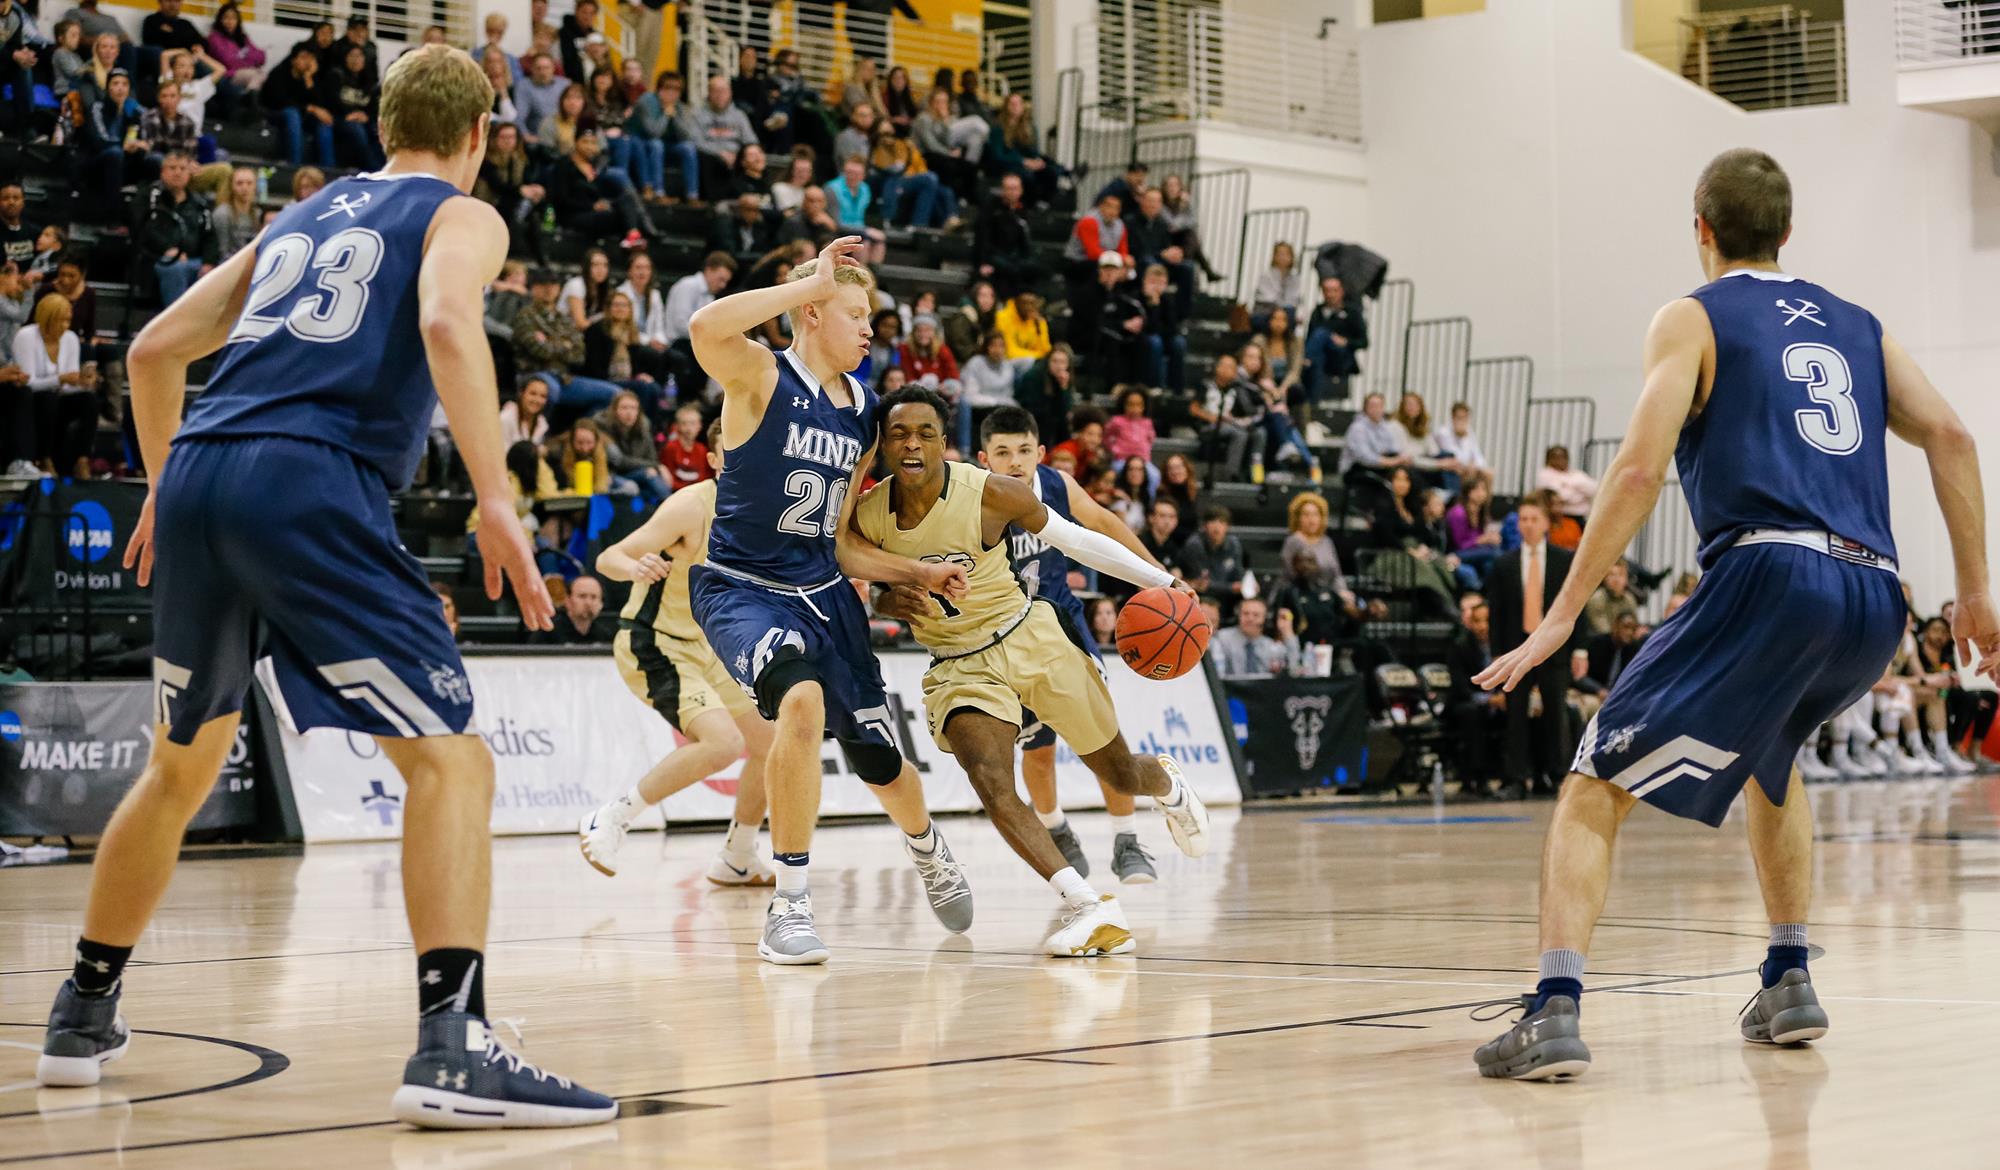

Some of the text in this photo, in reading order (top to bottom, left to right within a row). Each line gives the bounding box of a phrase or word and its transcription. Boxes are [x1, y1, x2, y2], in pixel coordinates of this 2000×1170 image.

[228, 227, 384, 343] 23
[1782, 342, 1862, 455] 3
[928, 590, 961, 618] 1
[20, 740, 104, 770] MAKE
[111, 740, 139, 769] IT
